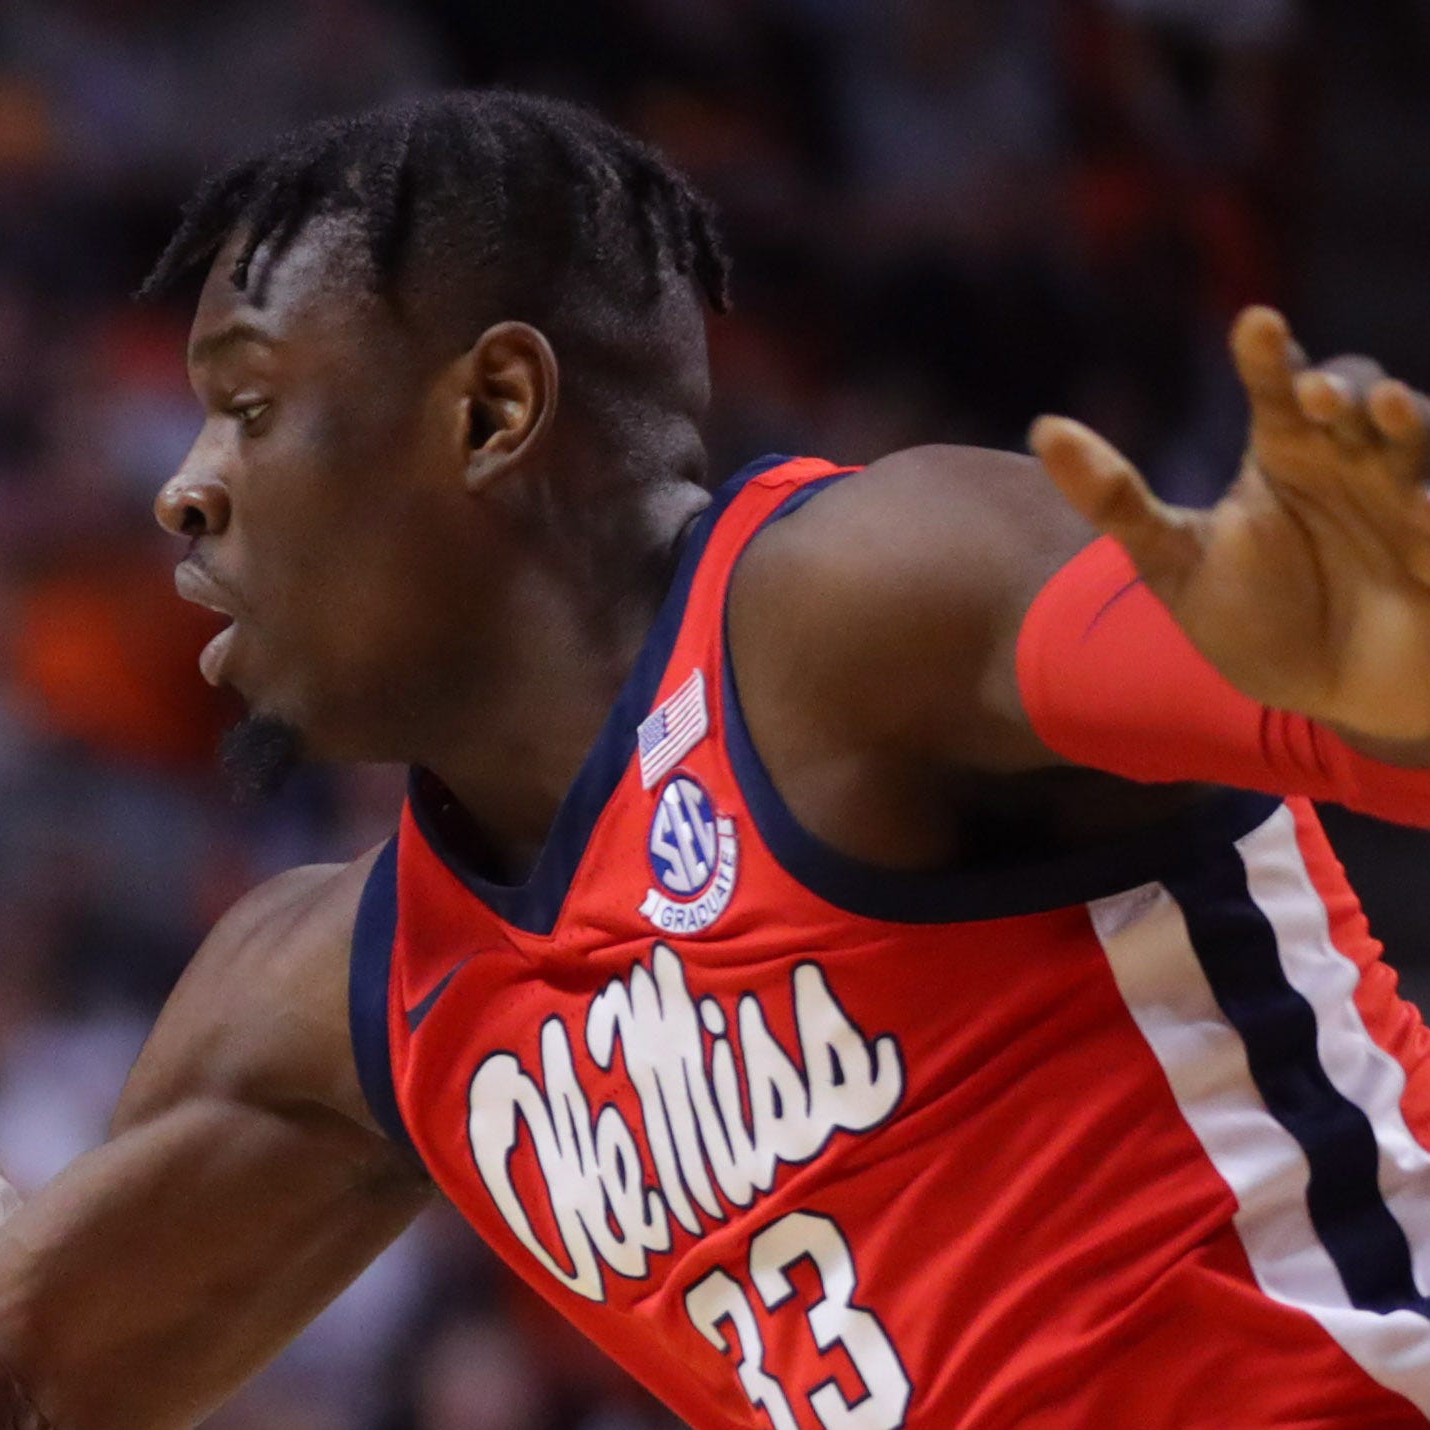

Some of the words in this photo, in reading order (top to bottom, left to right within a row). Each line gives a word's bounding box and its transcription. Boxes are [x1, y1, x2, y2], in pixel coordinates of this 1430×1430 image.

[649, 778, 716, 892] SEC
[660, 849, 736, 931] GRADUATE
[468, 1016, 672, 1301] Ole
[586, 940, 906, 1239] Miss
